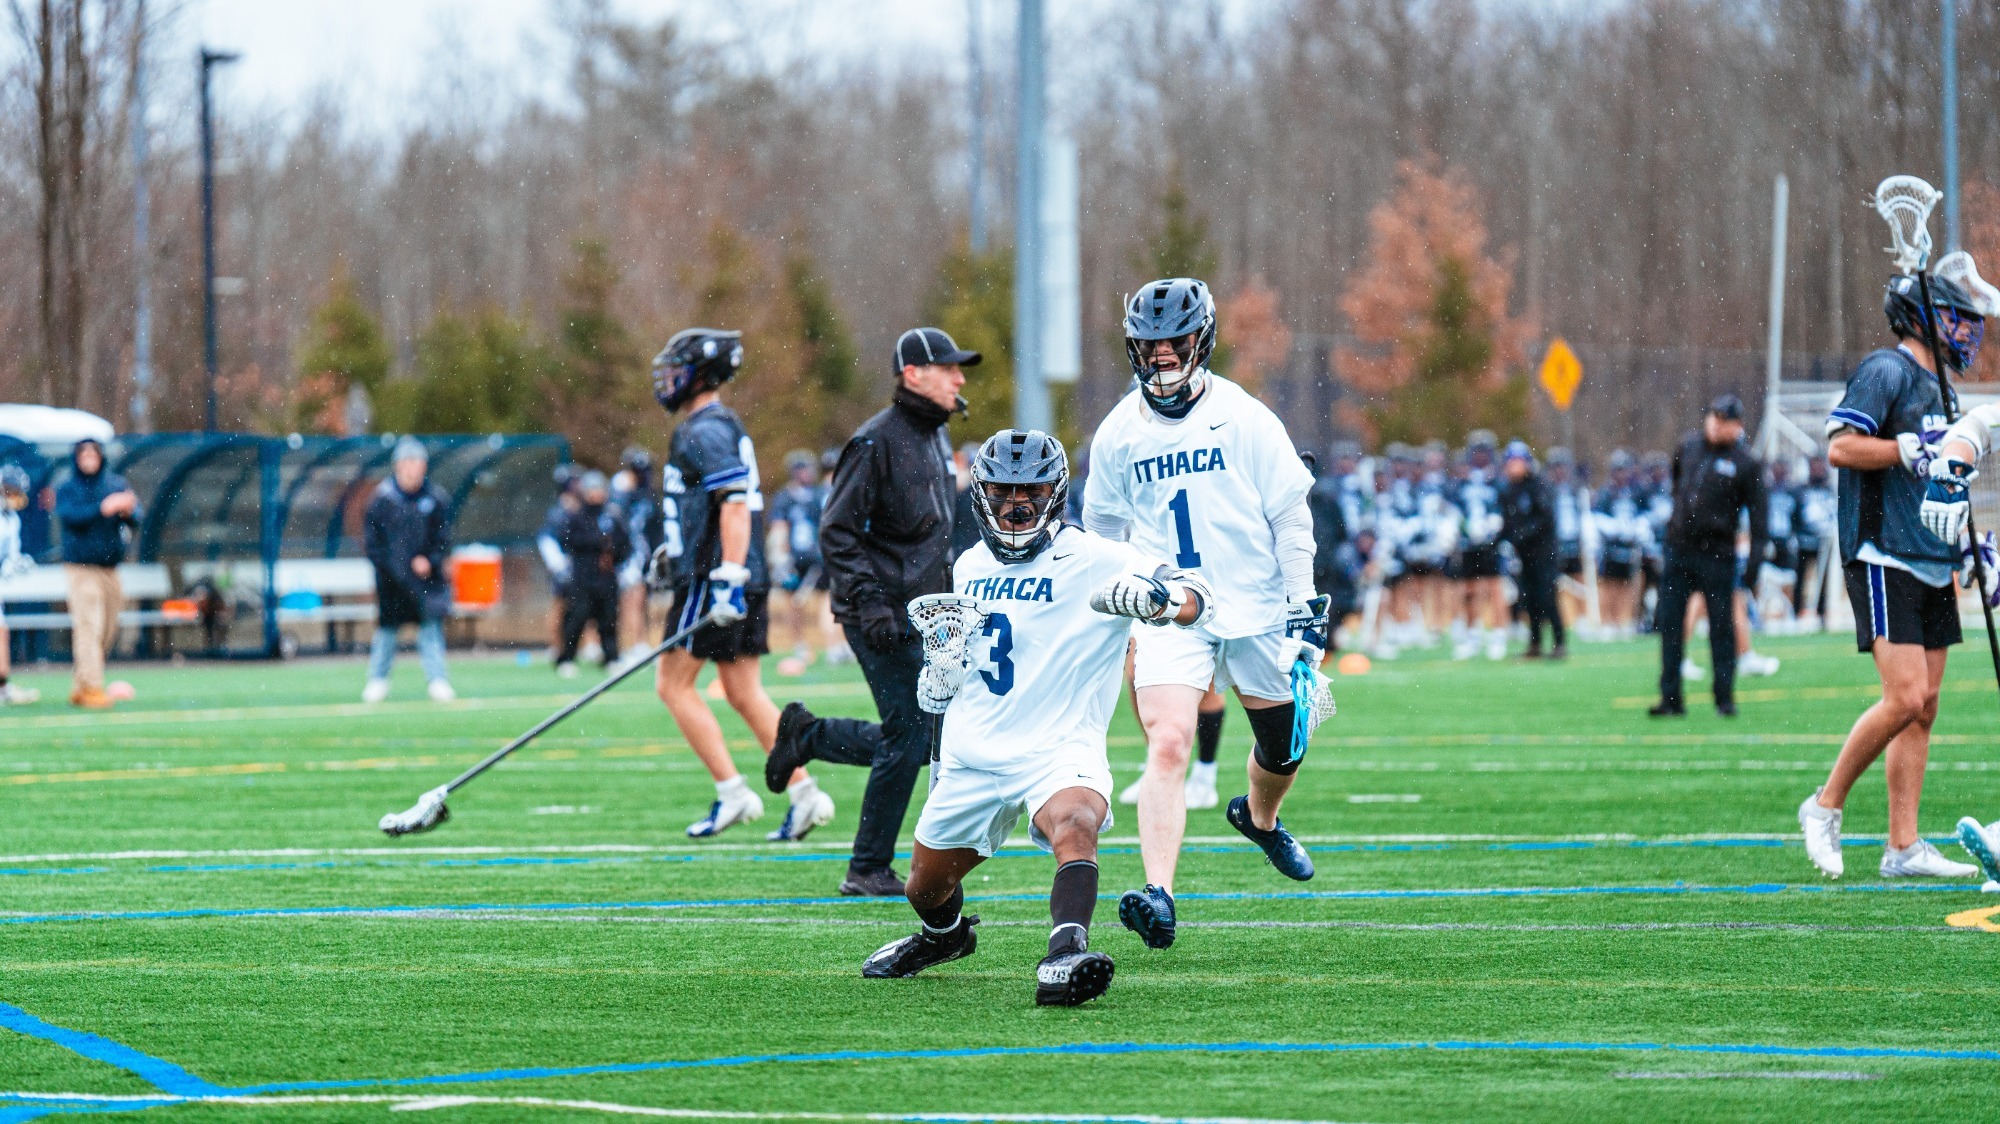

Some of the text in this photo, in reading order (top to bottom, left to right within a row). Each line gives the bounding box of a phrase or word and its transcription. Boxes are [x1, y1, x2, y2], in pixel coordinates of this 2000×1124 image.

[1133, 447, 1226, 484] ITHACA
[1168, 488, 1202, 569] 1
[964, 577, 1054, 602] ITHACA
[978, 612, 1015, 697] 3
